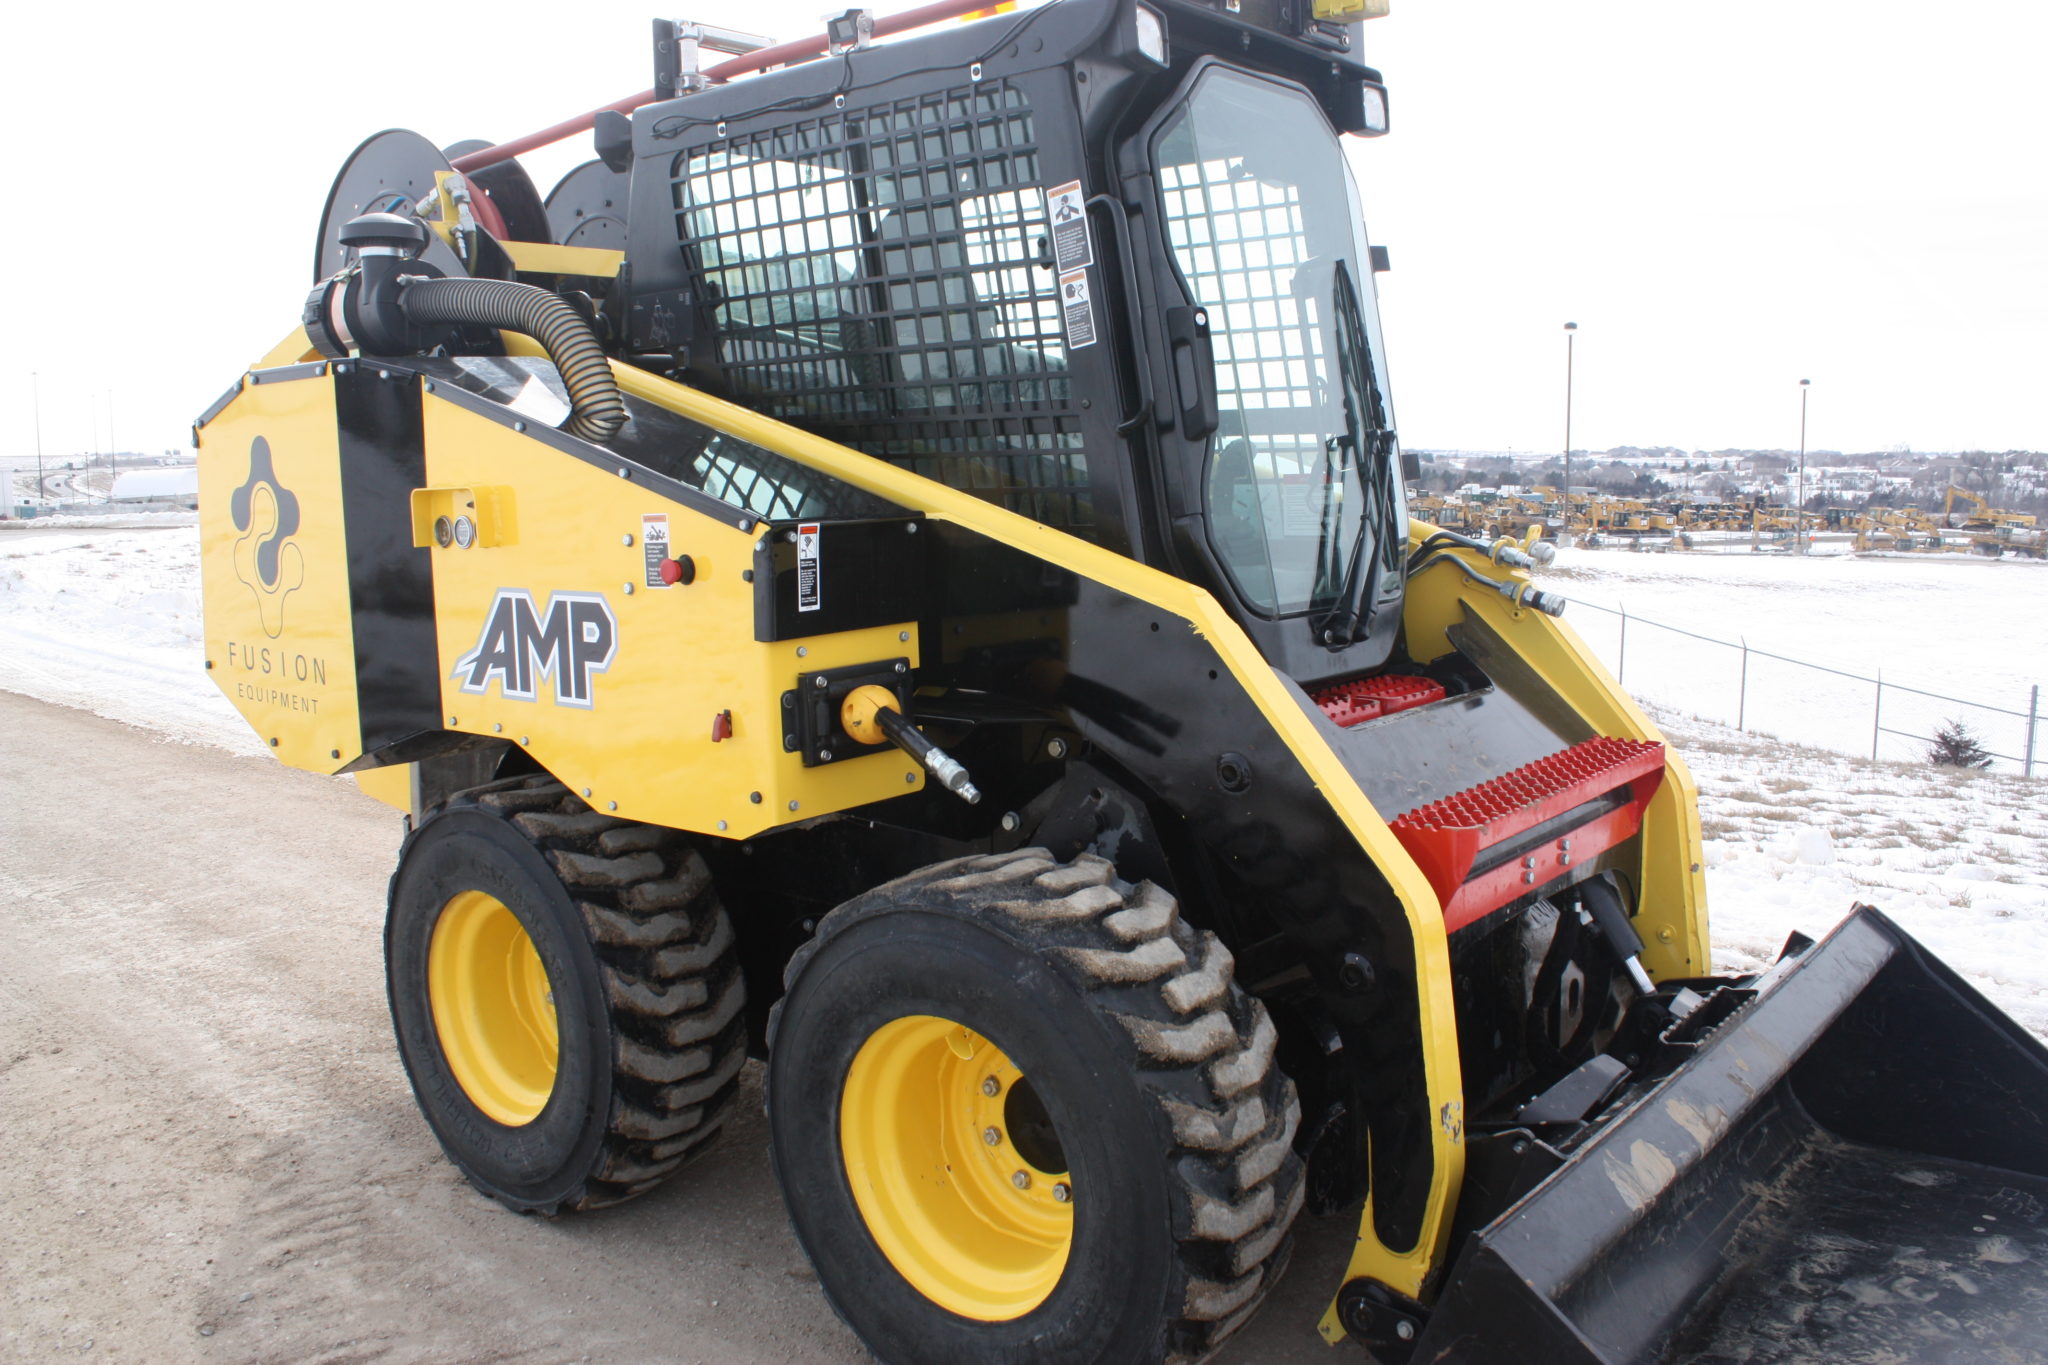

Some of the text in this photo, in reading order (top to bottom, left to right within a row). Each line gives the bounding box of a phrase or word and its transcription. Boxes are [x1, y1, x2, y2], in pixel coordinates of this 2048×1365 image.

[228, 641, 326, 686] FUSION
[453, 589, 616, 707] AMP
[238, 682, 319, 715] EQUIPMENT
